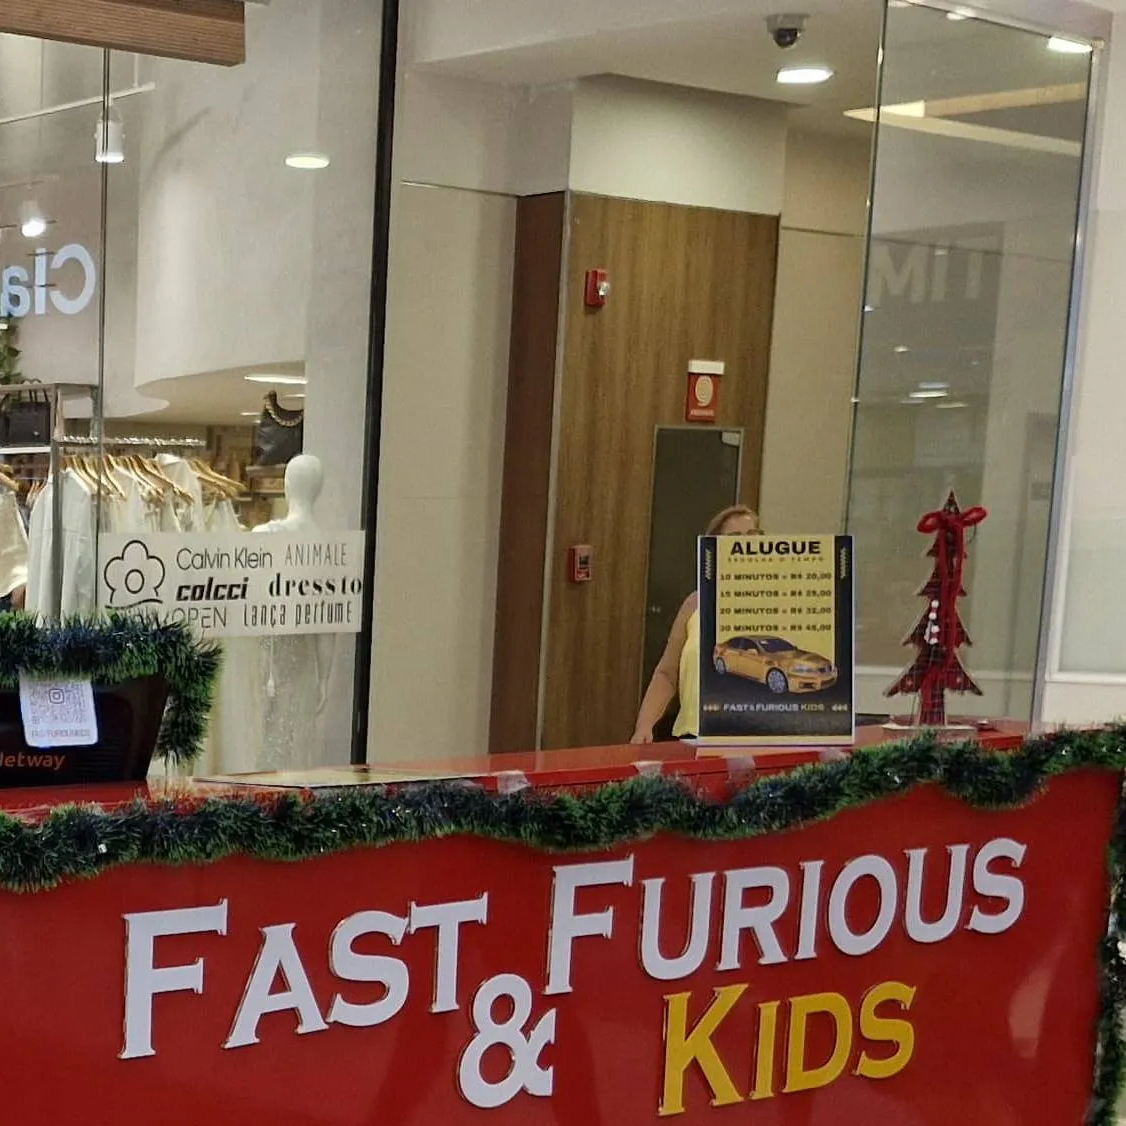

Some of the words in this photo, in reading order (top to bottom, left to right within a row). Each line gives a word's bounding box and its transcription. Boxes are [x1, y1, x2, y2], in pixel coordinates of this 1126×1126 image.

[730, 541, 822, 555] ALUGUE
[176, 547, 231, 571] Calvin
[234, 547, 273, 569] Klein
[284, 543, 347, 567] ANIMALE
[734, 572, 779, 580] MINUTOS
[176, 576, 249, 601] colcci
[734, 590, 779, 598] MINUTOS
[172, 607, 227, 629] OPEN
[734, 607, 779, 615] MINUTOS
[734, 624, 779, 632] MINUTOS
[800, 703, 825, 712] KIDS
[117, 891, 489, 1060] FAST
[458, 972, 557, 1109] &
[542, 836, 1029, 997] FURIOUS
[658, 980, 917, 1117] KIDS
